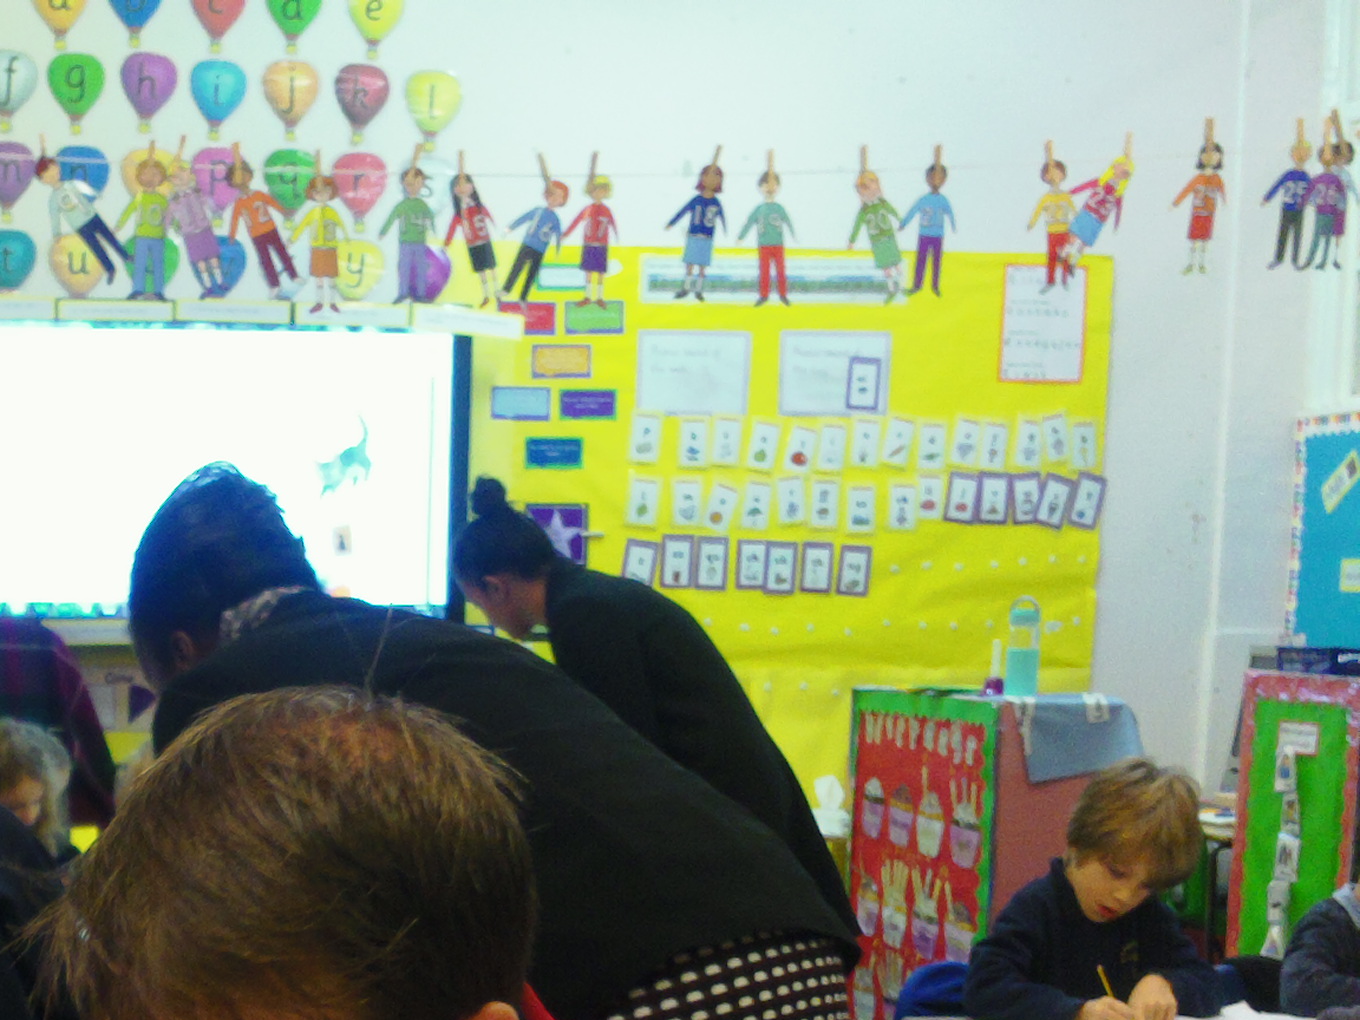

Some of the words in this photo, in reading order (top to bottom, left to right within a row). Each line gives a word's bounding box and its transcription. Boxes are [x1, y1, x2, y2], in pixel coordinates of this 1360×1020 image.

[64, 64, 86, 104] g
[136, 61, 157, 99] h
[281, 63, 297, 115] j
[693, 204, 719, 228] 18
[865, 209, 892, 236] 20
[67, 250, 90, 275] u
[346, 252, 367, 289] y
